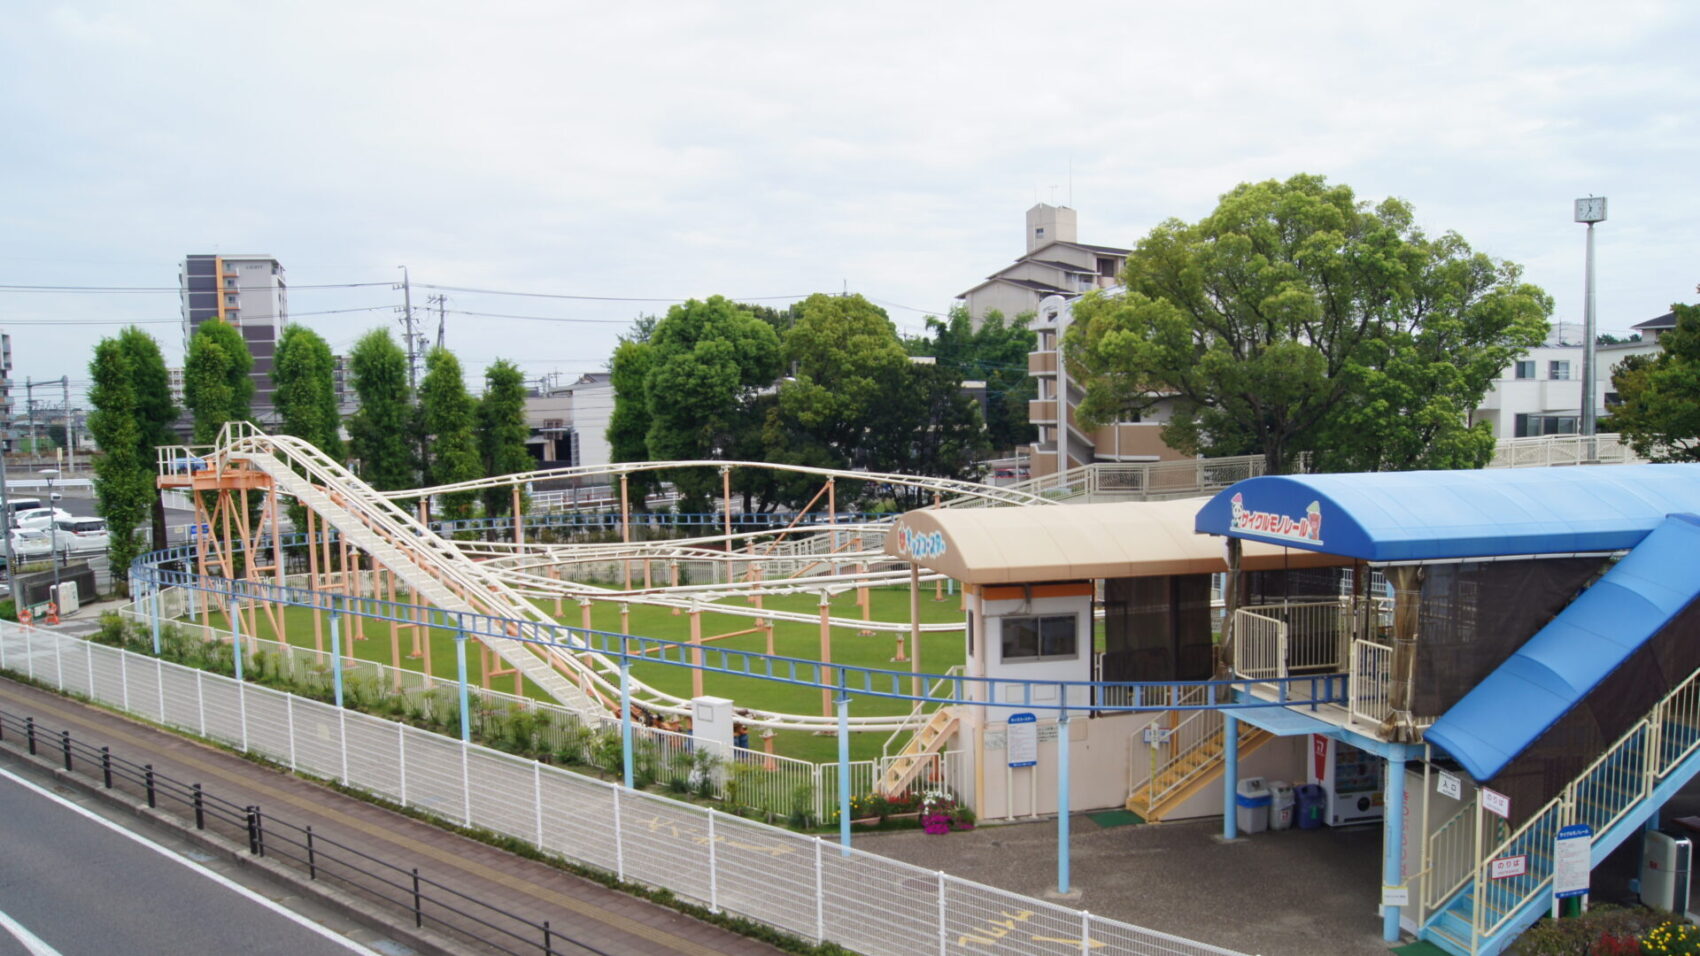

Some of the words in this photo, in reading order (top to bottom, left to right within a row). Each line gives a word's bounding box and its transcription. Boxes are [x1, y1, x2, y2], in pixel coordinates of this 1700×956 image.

[1241, 510, 1309, 537] サイクルモノレール
[1443, 780, 1457, 792] 入口
[1487, 793, 1505, 807] のりば
[1497, 859, 1520, 870] のりば
